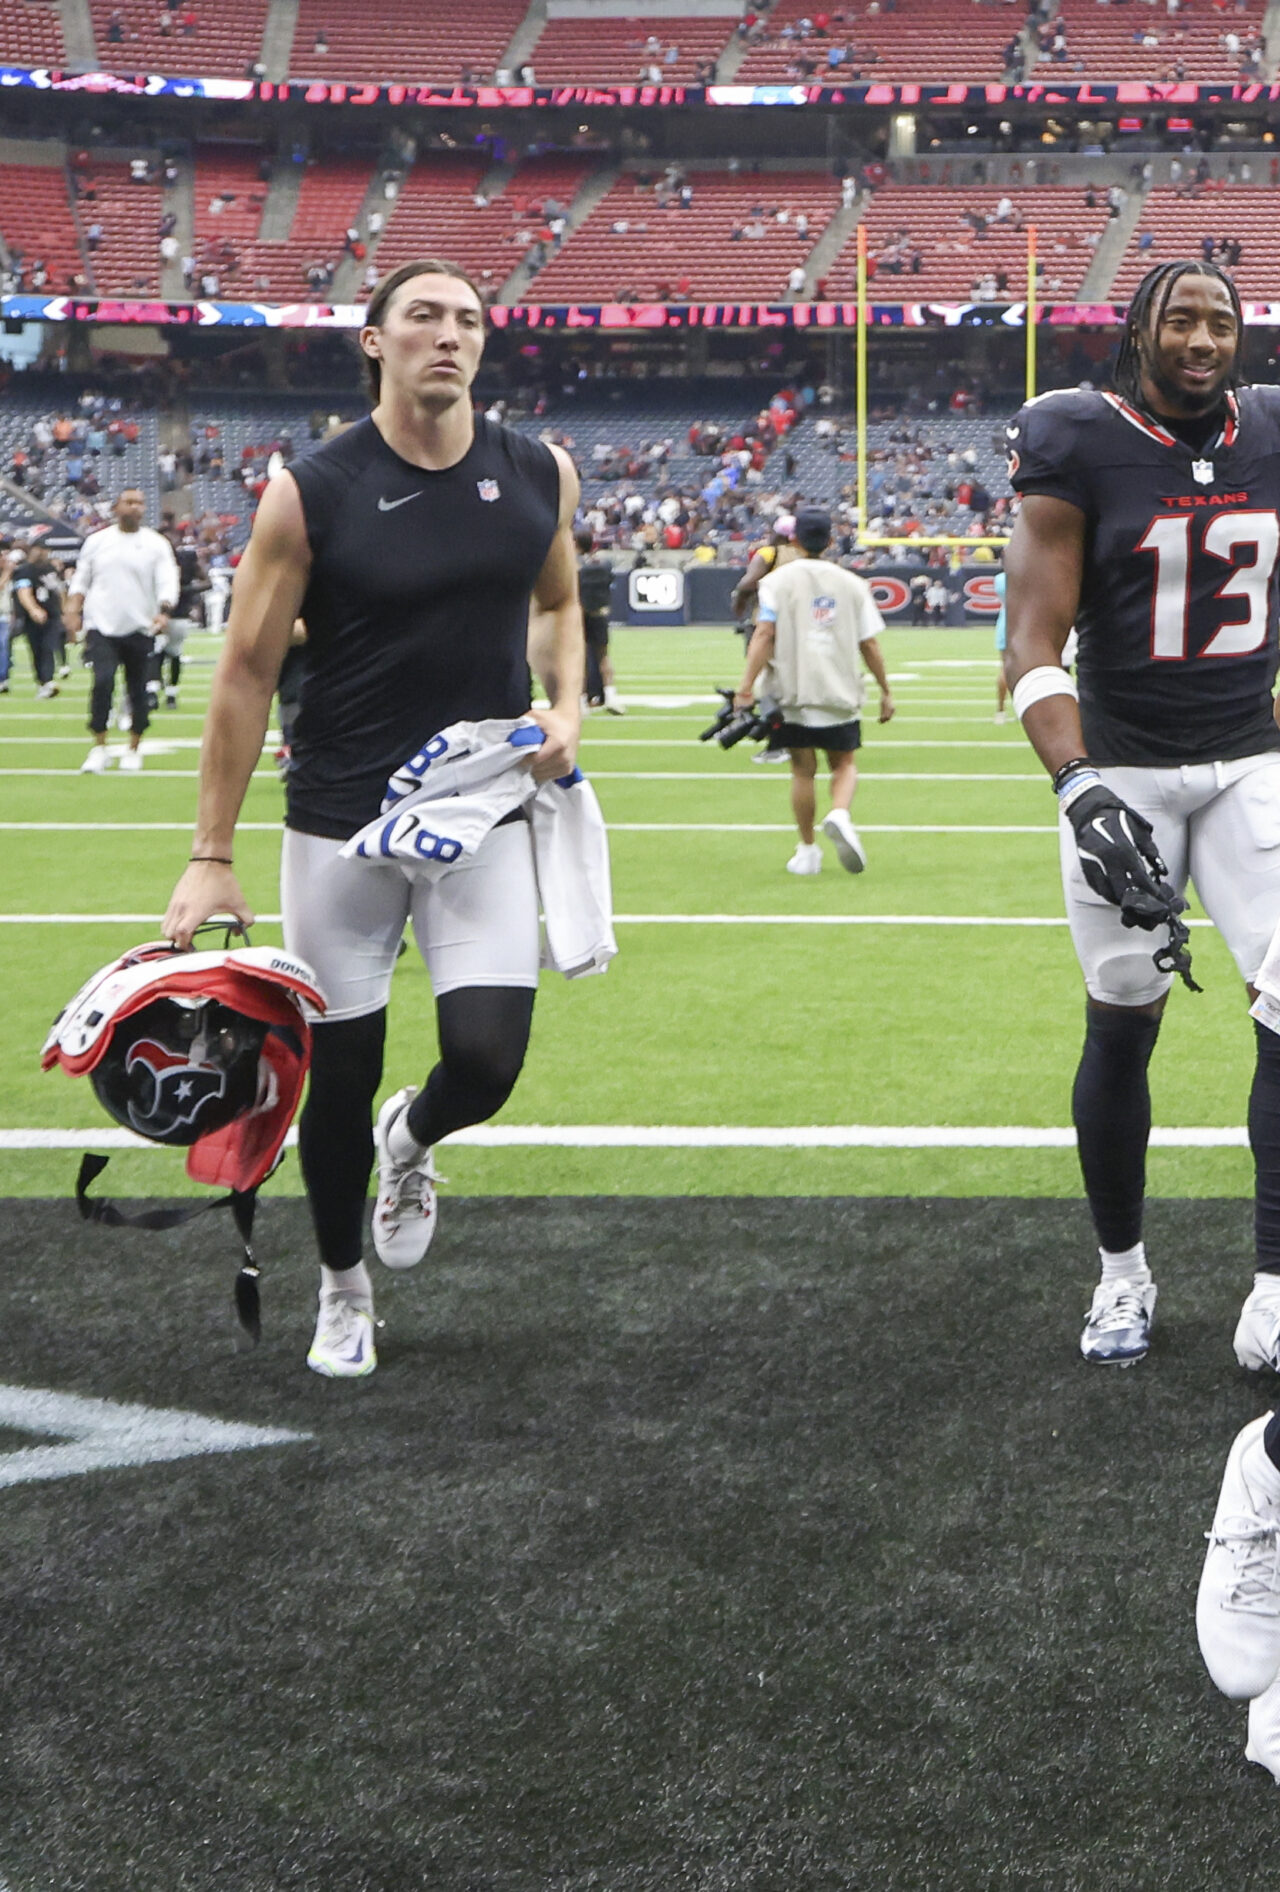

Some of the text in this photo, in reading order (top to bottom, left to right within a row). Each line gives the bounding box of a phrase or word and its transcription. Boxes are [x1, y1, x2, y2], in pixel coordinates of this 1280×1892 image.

[1160, 491, 1248, 508] TEXANS
[404, 735, 449, 777] 8
[415, 829, 464, 864] 8
